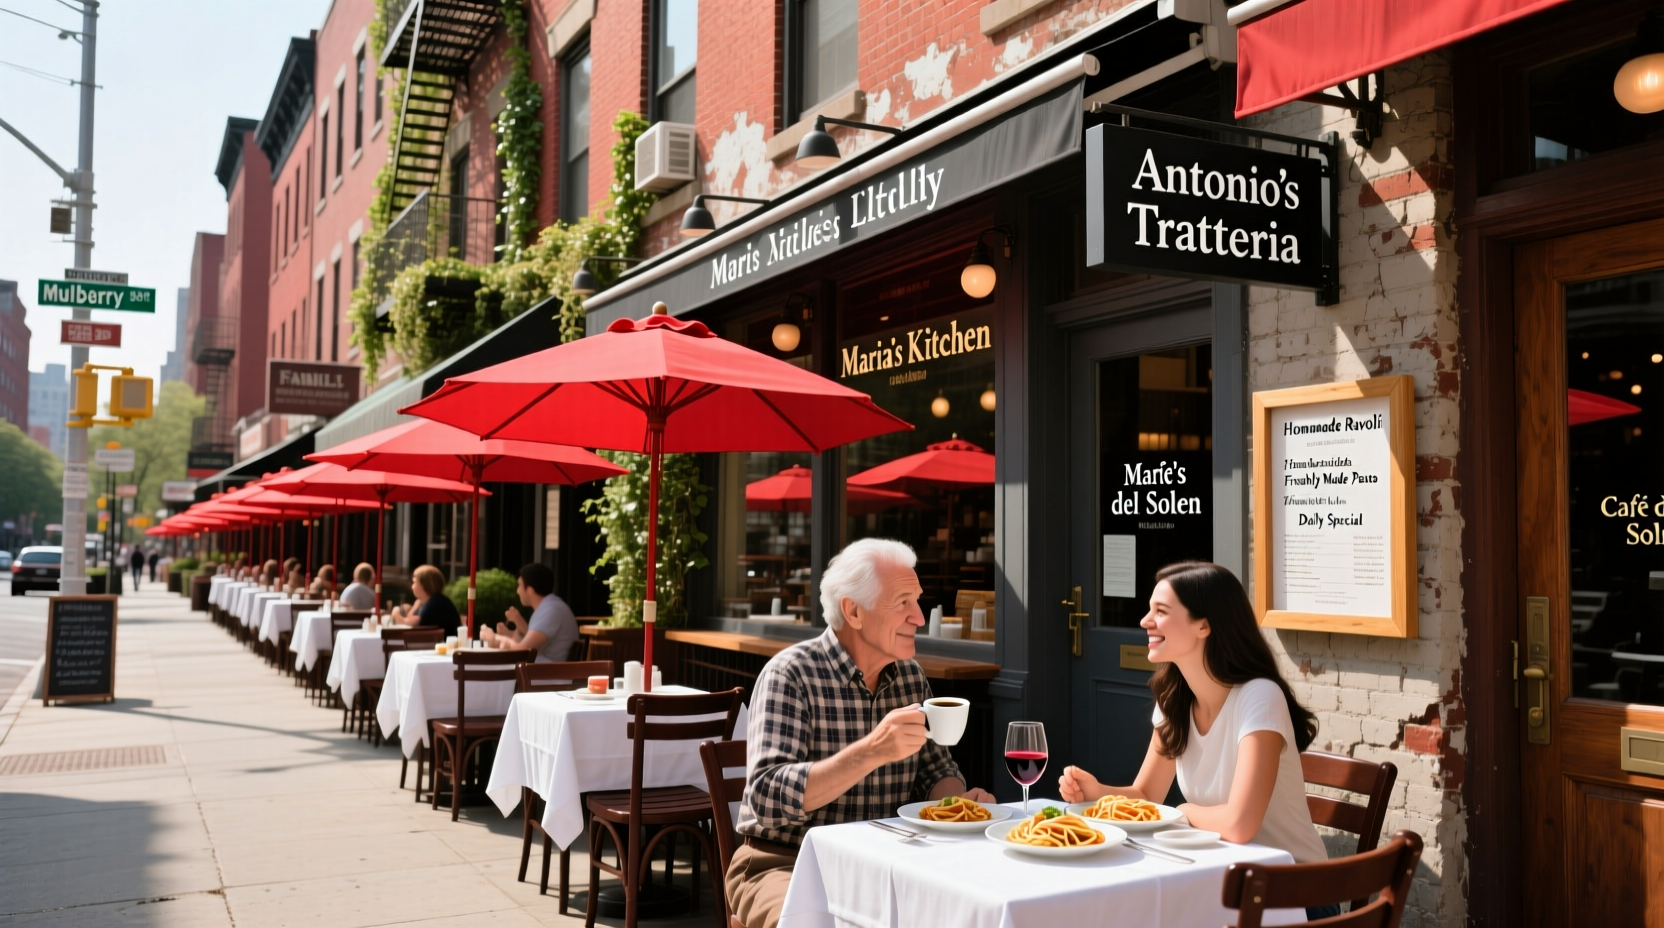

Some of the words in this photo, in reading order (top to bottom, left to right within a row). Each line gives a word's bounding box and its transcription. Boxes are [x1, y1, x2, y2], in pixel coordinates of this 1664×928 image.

[1127, 201, 1301, 265] Tratteria
[43, 283, 124, 309] Mulberry
[840, 336, 903, 378] Maria's
[907, 319, 992, 364] Kitchen
[1111, 490, 1139, 515] del
[1146, 490, 1202, 515] Solen
[1600, 493, 1649, 518] Café
[1626, 521, 1664, 546] Sol
